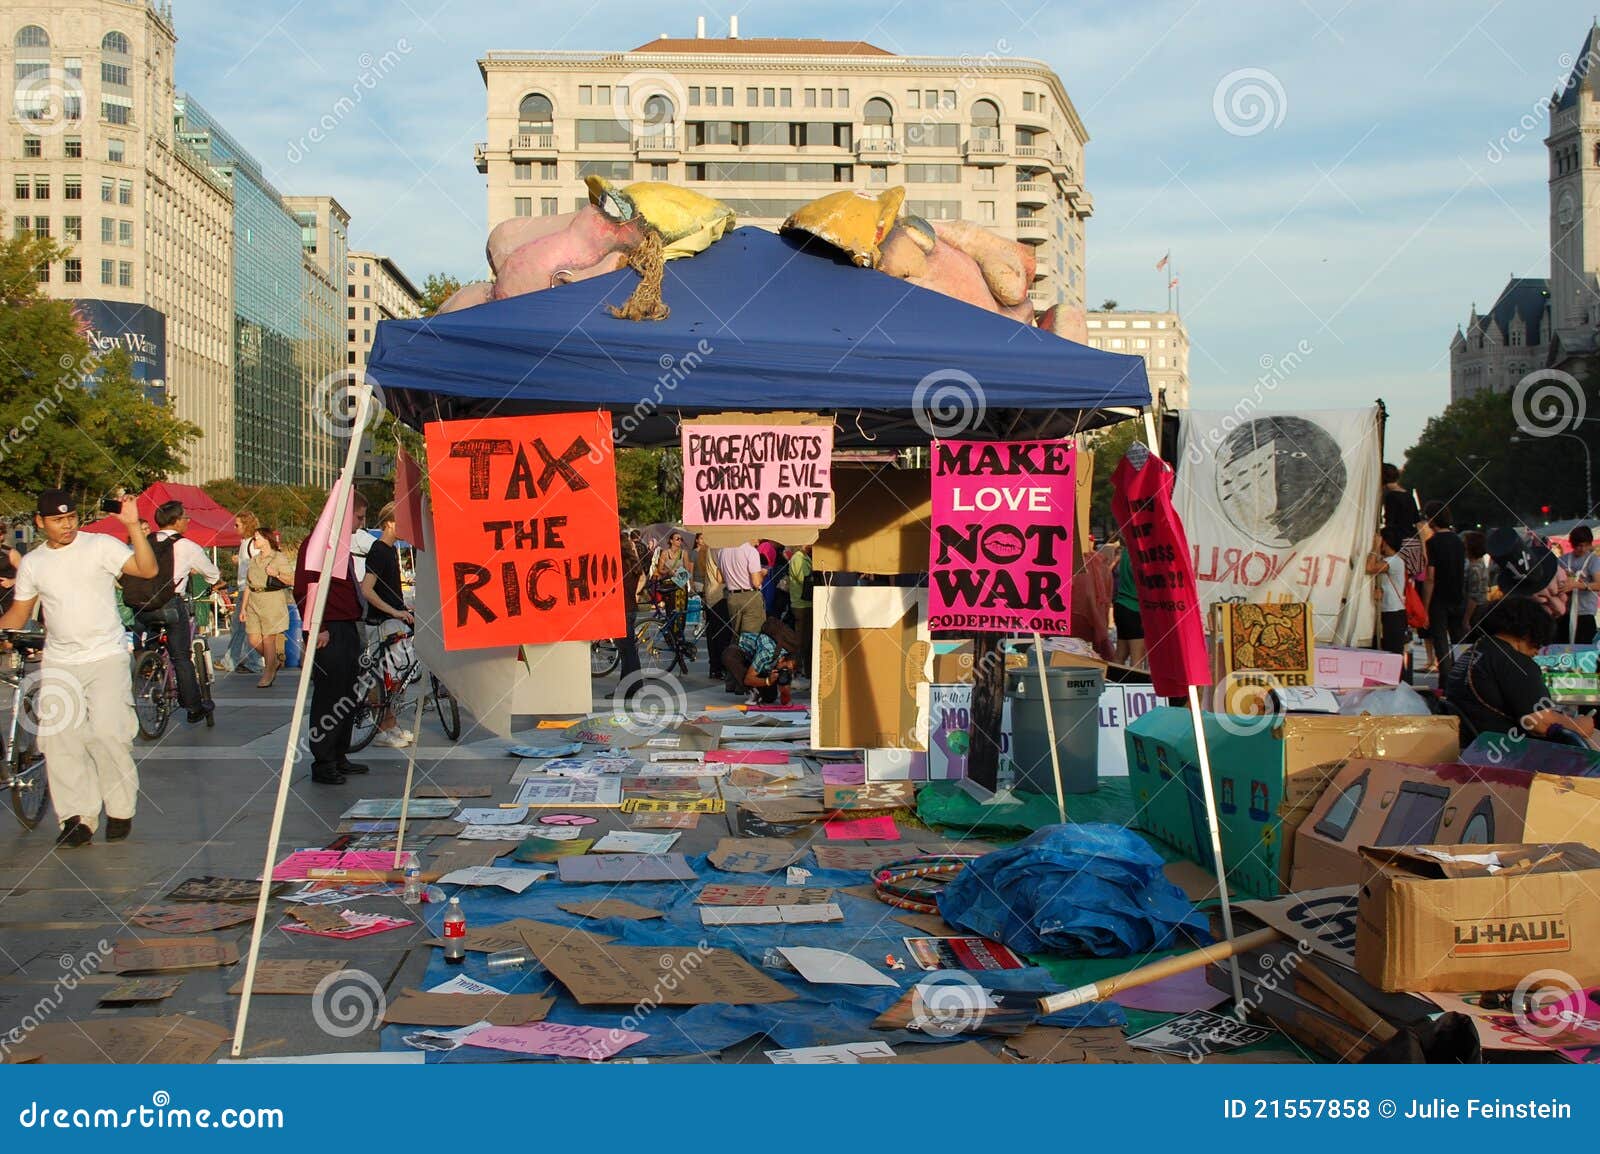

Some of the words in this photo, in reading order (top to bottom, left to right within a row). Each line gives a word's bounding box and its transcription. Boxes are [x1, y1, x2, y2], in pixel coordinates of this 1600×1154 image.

[86, 330, 120, 351] New
[450, 435, 591, 500] TAX
[936, 443, 1071, 476] MAKE
[696, 462, 765, 492] COMBAT
[700, 492, 760, 523] WARS
[952, 487, 1051, 512] LOVE
[482, 515, 568, 550] THE
[936, 523, 1068, 566] NOT
[453, 553, 618, 627] RICH!!!
[933, 569, 1066, 612] WAR
[929, 614, 1067, 632] CODEPINK.ORG
[1067, 679, 1096, 689] BRUTE
[1232, 674, 1308, 687] THEATER
